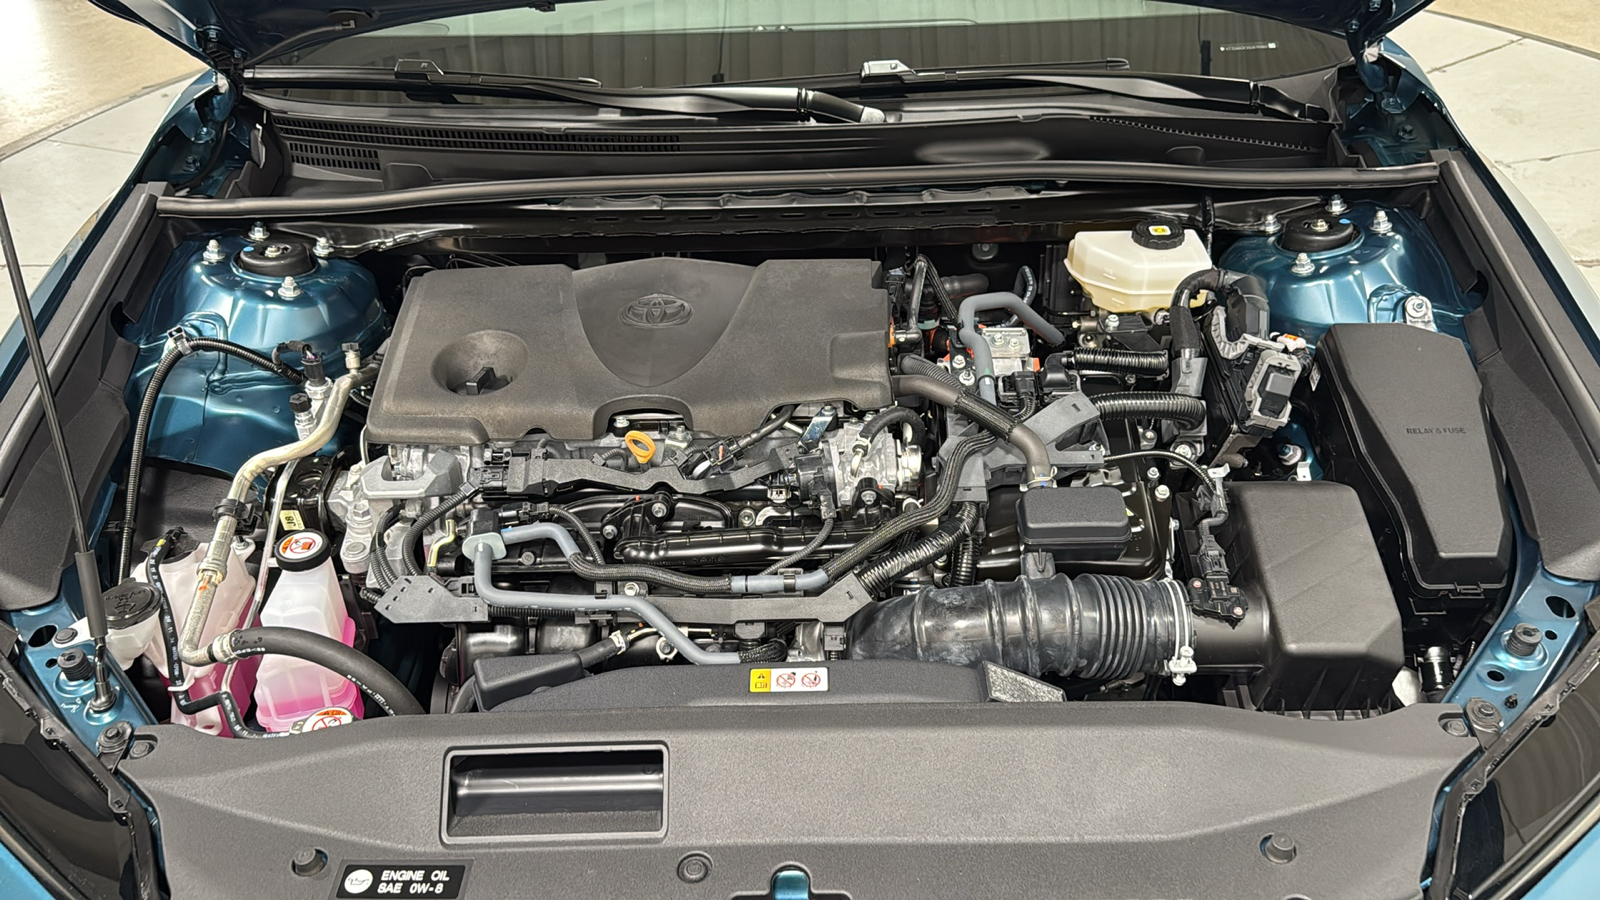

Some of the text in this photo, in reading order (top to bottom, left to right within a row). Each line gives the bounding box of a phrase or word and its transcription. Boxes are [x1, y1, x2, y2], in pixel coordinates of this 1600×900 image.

[381, 870, 450, 881] ENGINE OIL
[377, 883, 444, 894] SAE 0W-8
